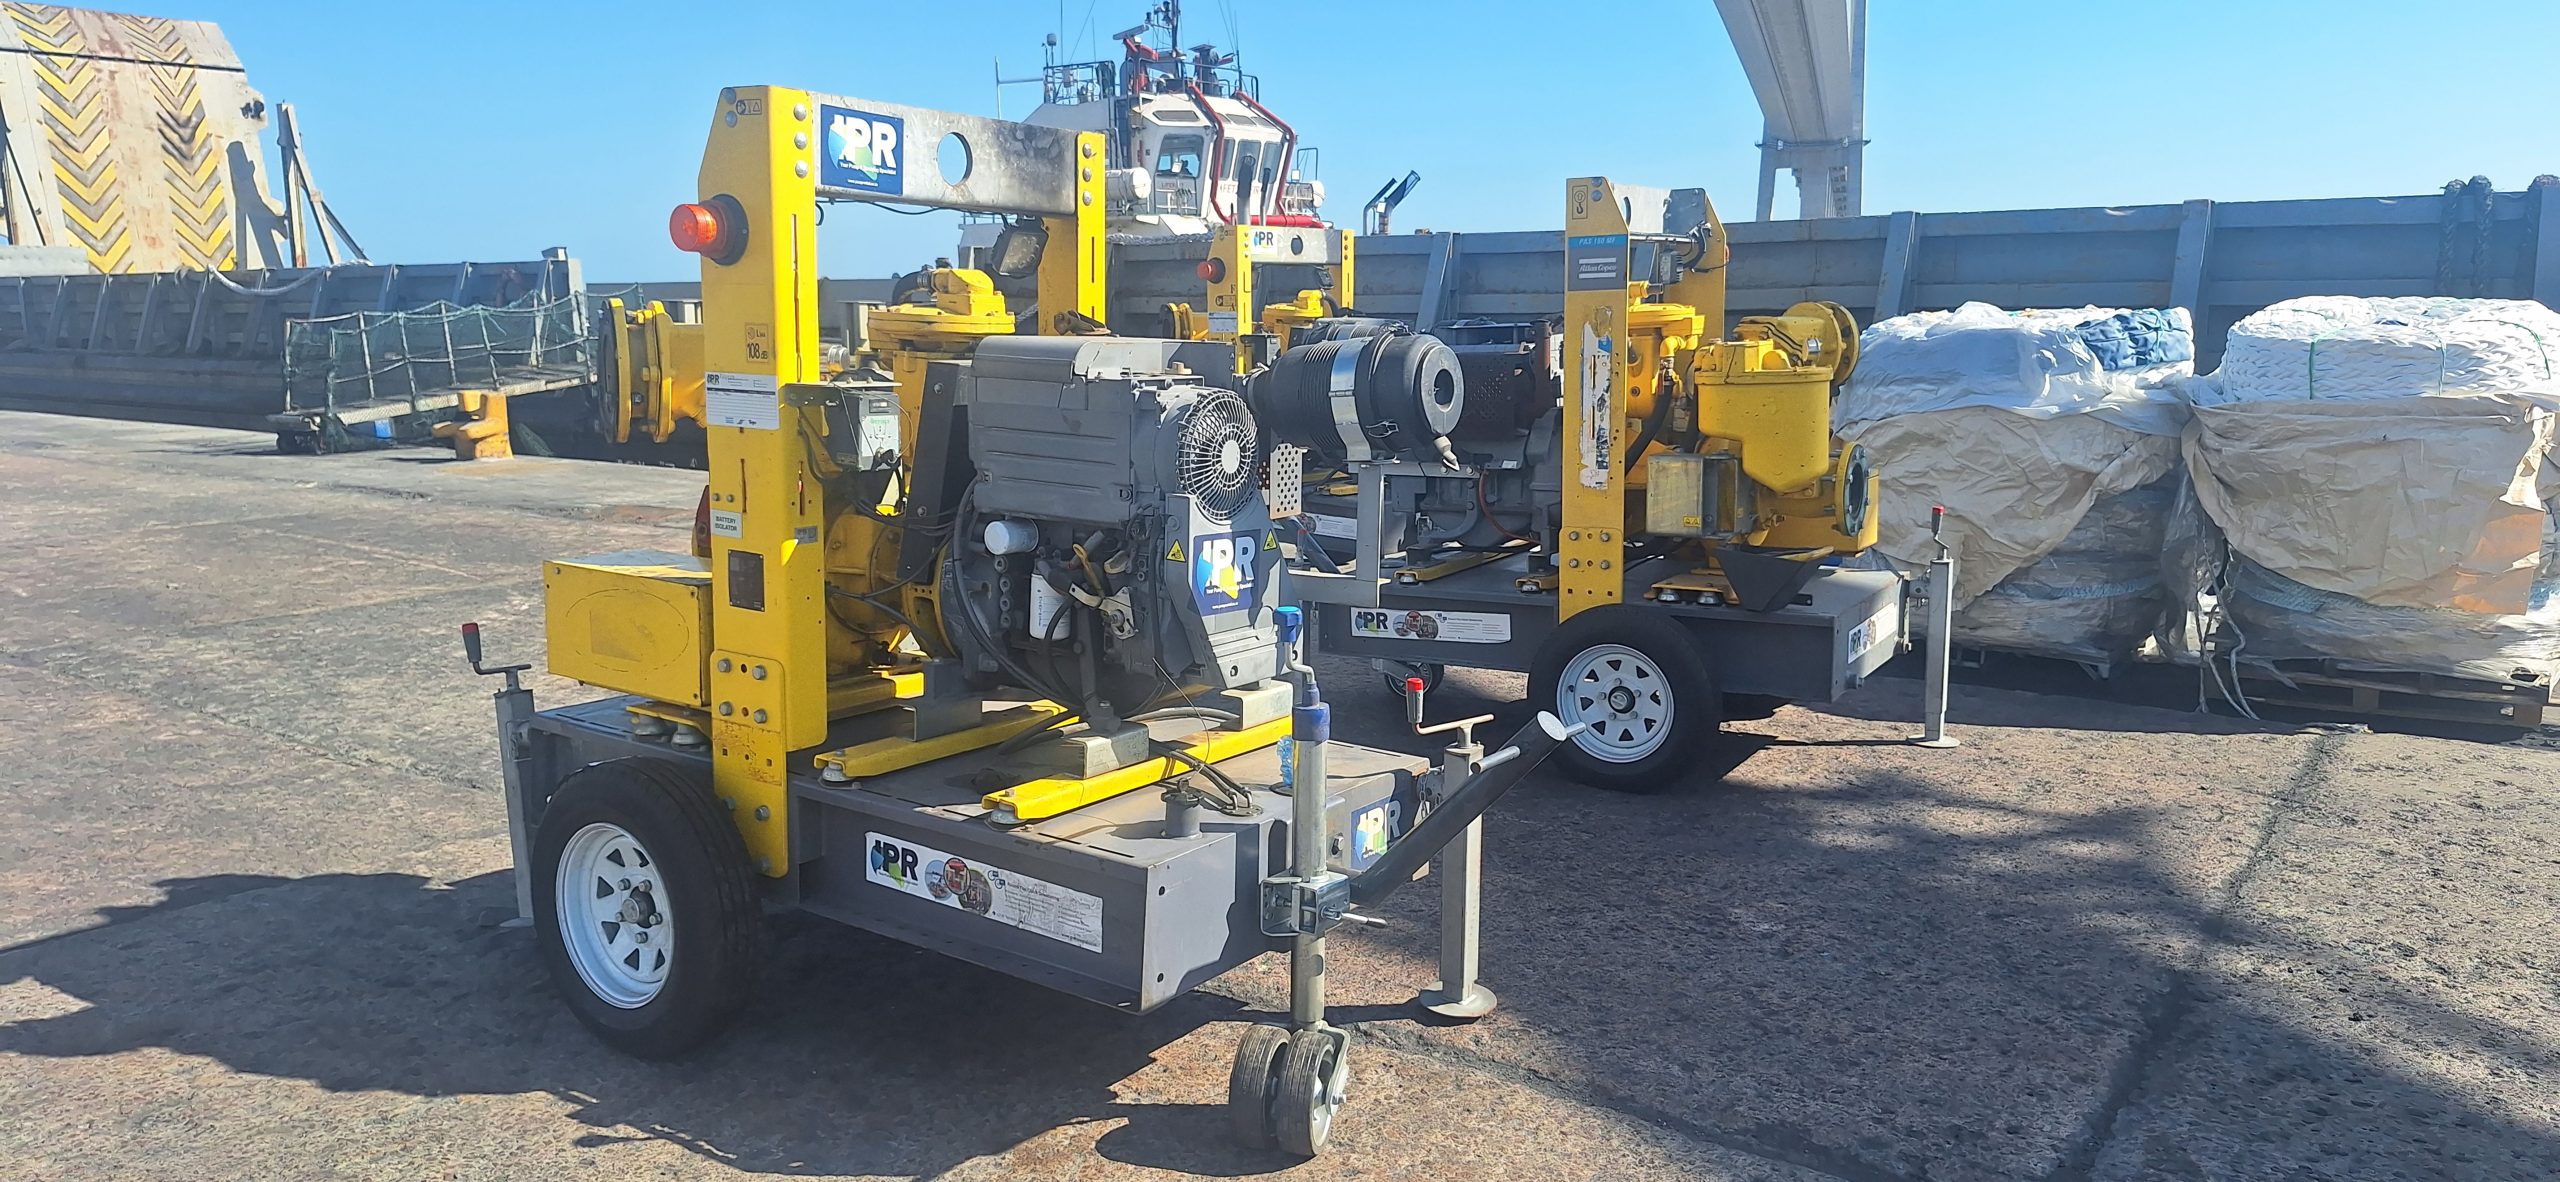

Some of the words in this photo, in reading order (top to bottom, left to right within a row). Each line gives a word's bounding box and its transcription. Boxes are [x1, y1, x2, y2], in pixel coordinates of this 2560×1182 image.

[1579, 264, 1598, 273] Atlas
[1598, 263, 1616, 273] Copco
[747, 342, 761, 359] 108
[715, 515, 737, 524] BATTERY
[715, 523, 737, 532] ISOLATOR
